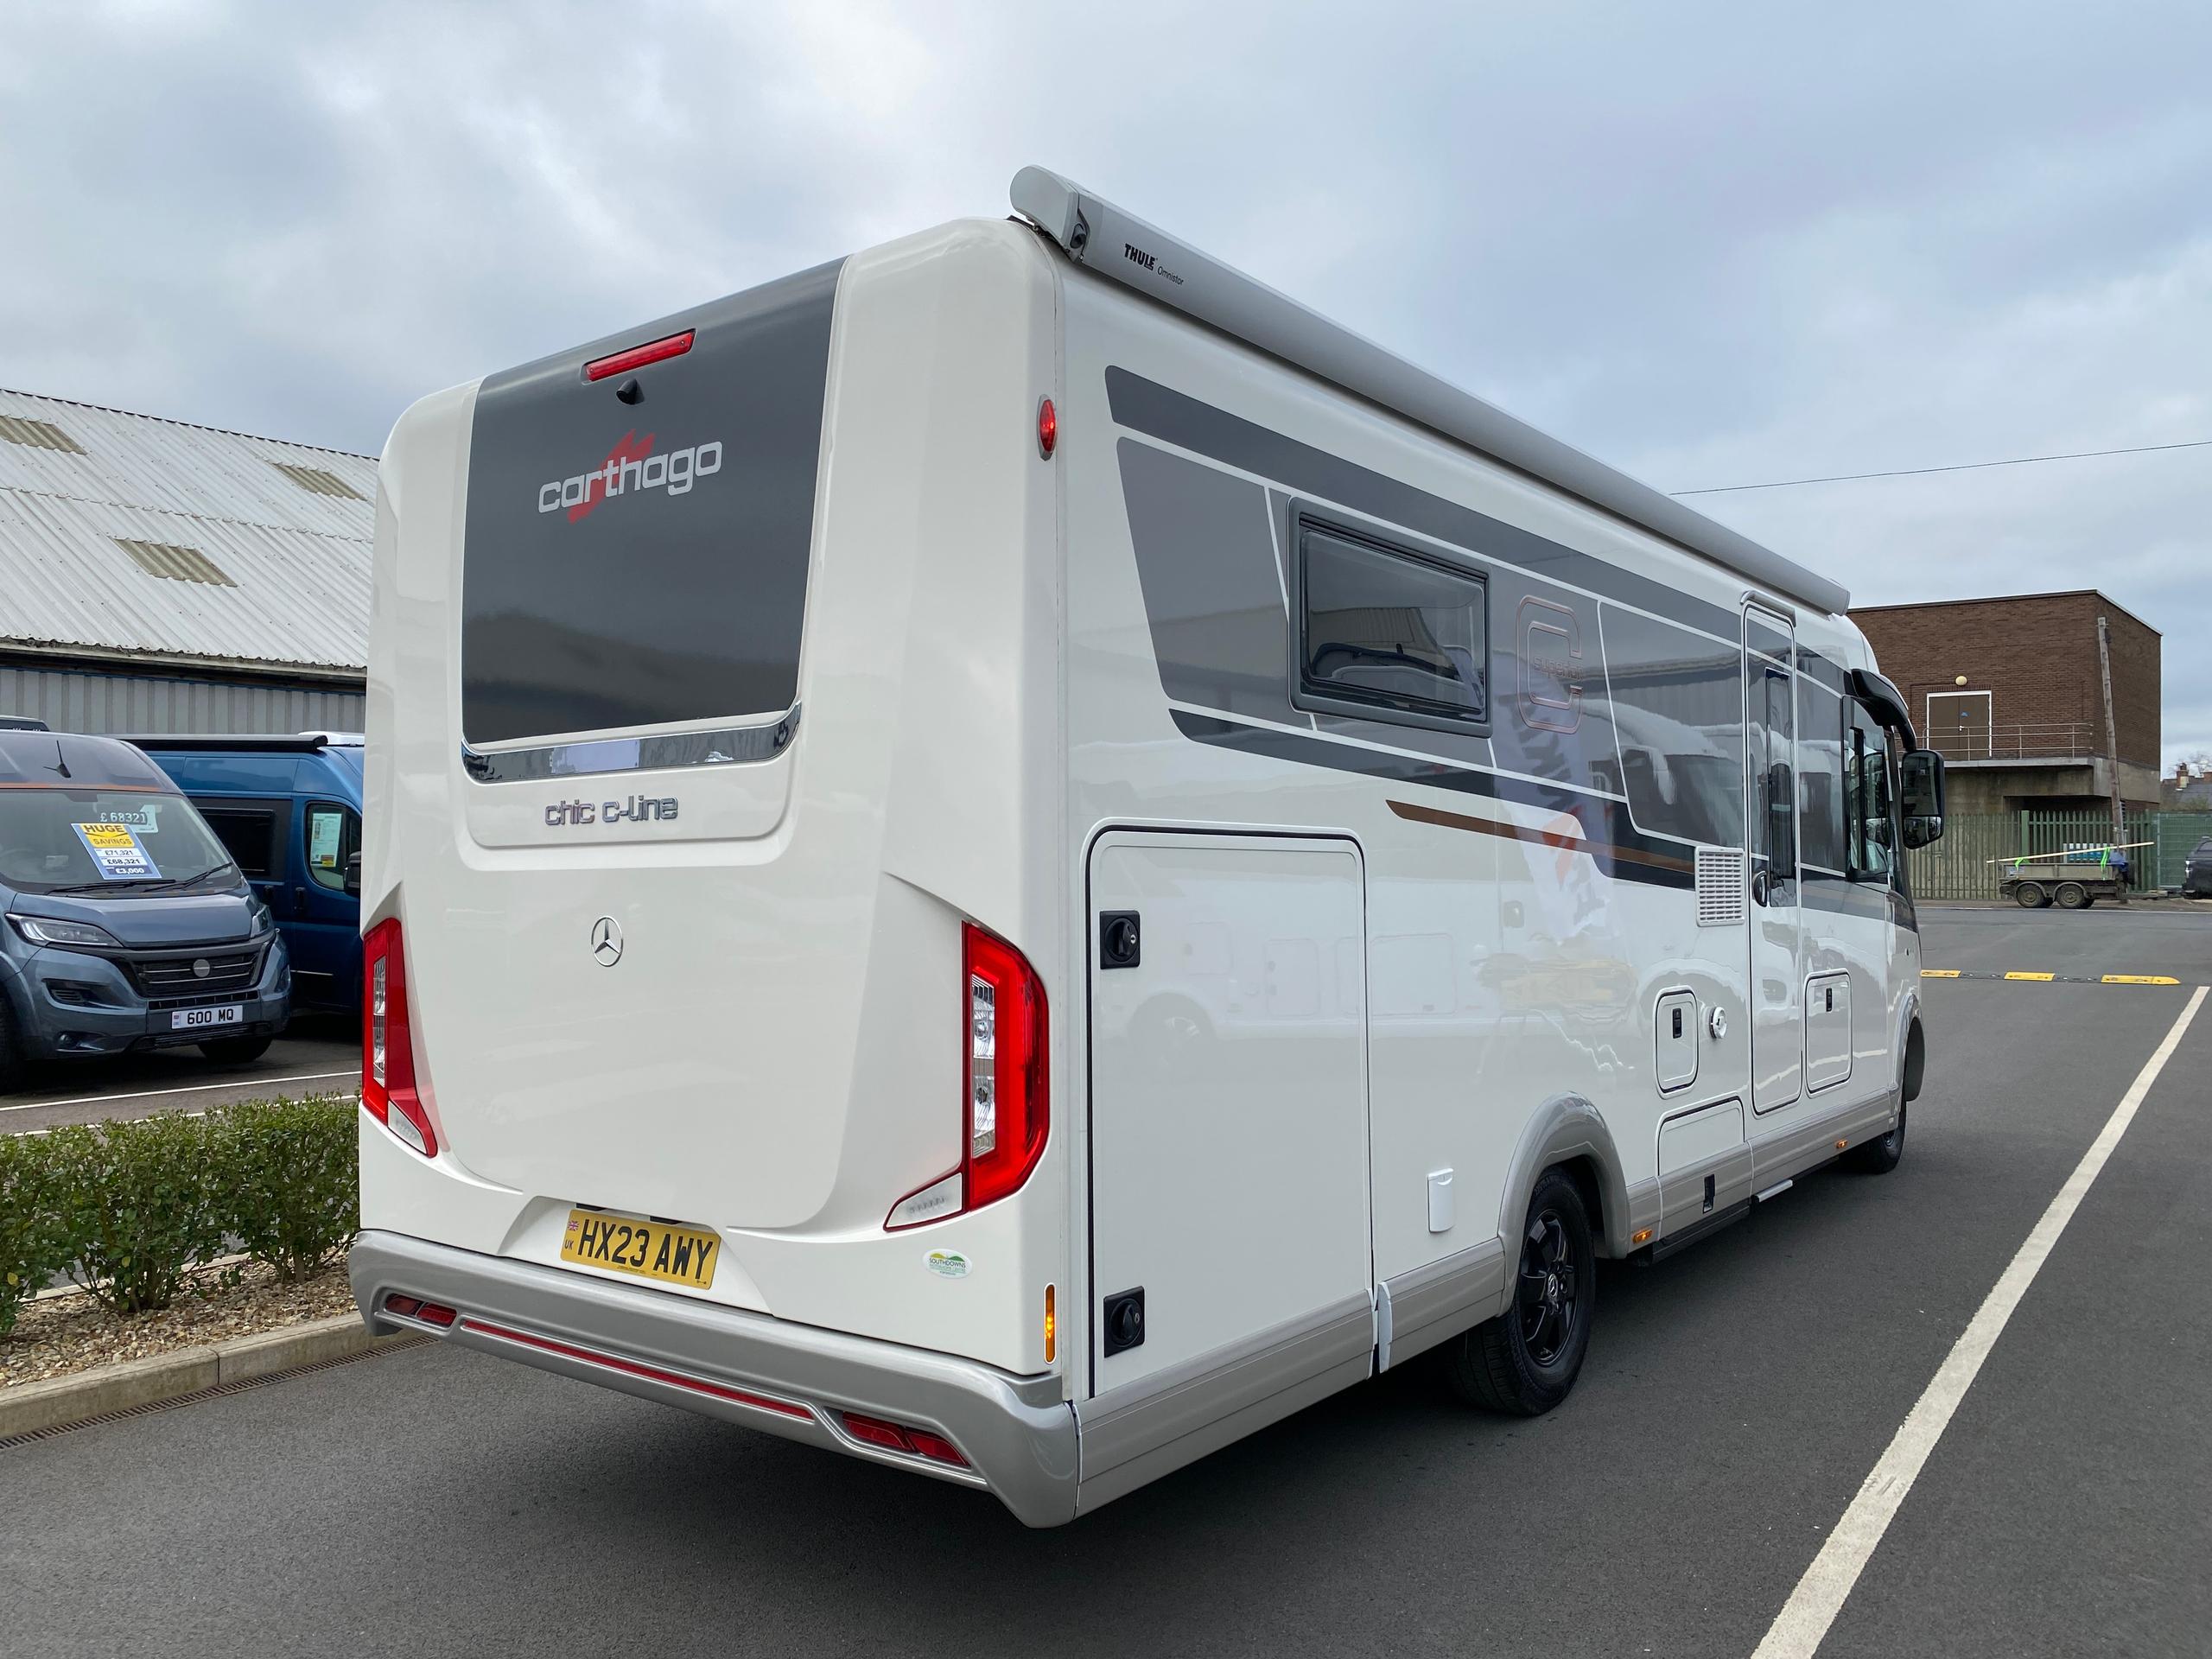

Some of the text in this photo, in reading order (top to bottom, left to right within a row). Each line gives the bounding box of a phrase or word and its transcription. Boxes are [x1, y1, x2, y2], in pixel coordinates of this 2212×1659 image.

[1124, 243, 1185, 286] THULE Omnistor
[537, 441, 723, 513] carthago
[544, 795, 678, 826] chic c-line
[83, 824, 125, 833] HUGE
[187, 1008, 234, 1025] 600 MQ
[564, 1239, 575, 1251] UK
[577, 1219, 714, 1280] HX23 AWY
